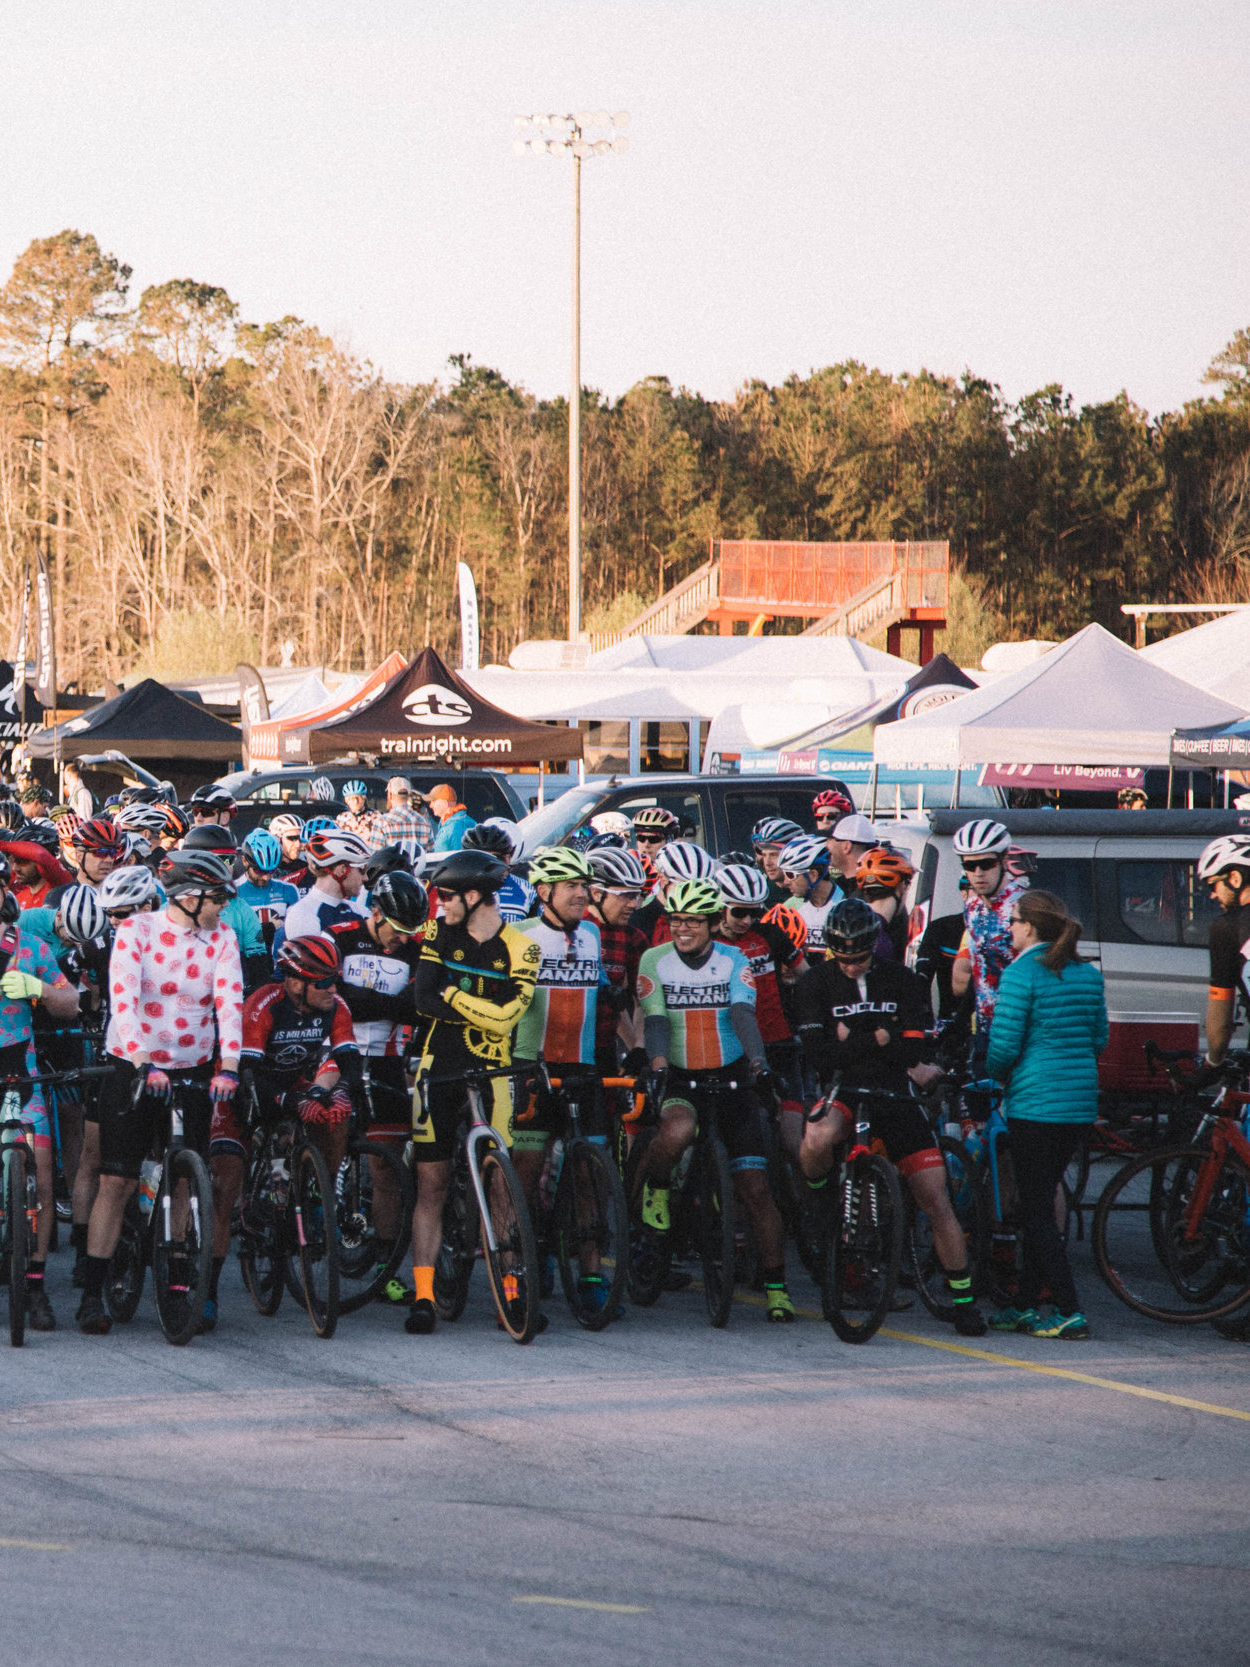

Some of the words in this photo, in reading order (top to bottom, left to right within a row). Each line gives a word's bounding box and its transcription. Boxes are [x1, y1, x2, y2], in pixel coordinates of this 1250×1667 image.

[380, 735, 512, 756] trainright.com
[1053, 764, 1072, 776] Liv
[1074, 765, 1122, 779] Beyond.
[358, 957, 375, 970] the
[348, 963, 381, 982] happy
